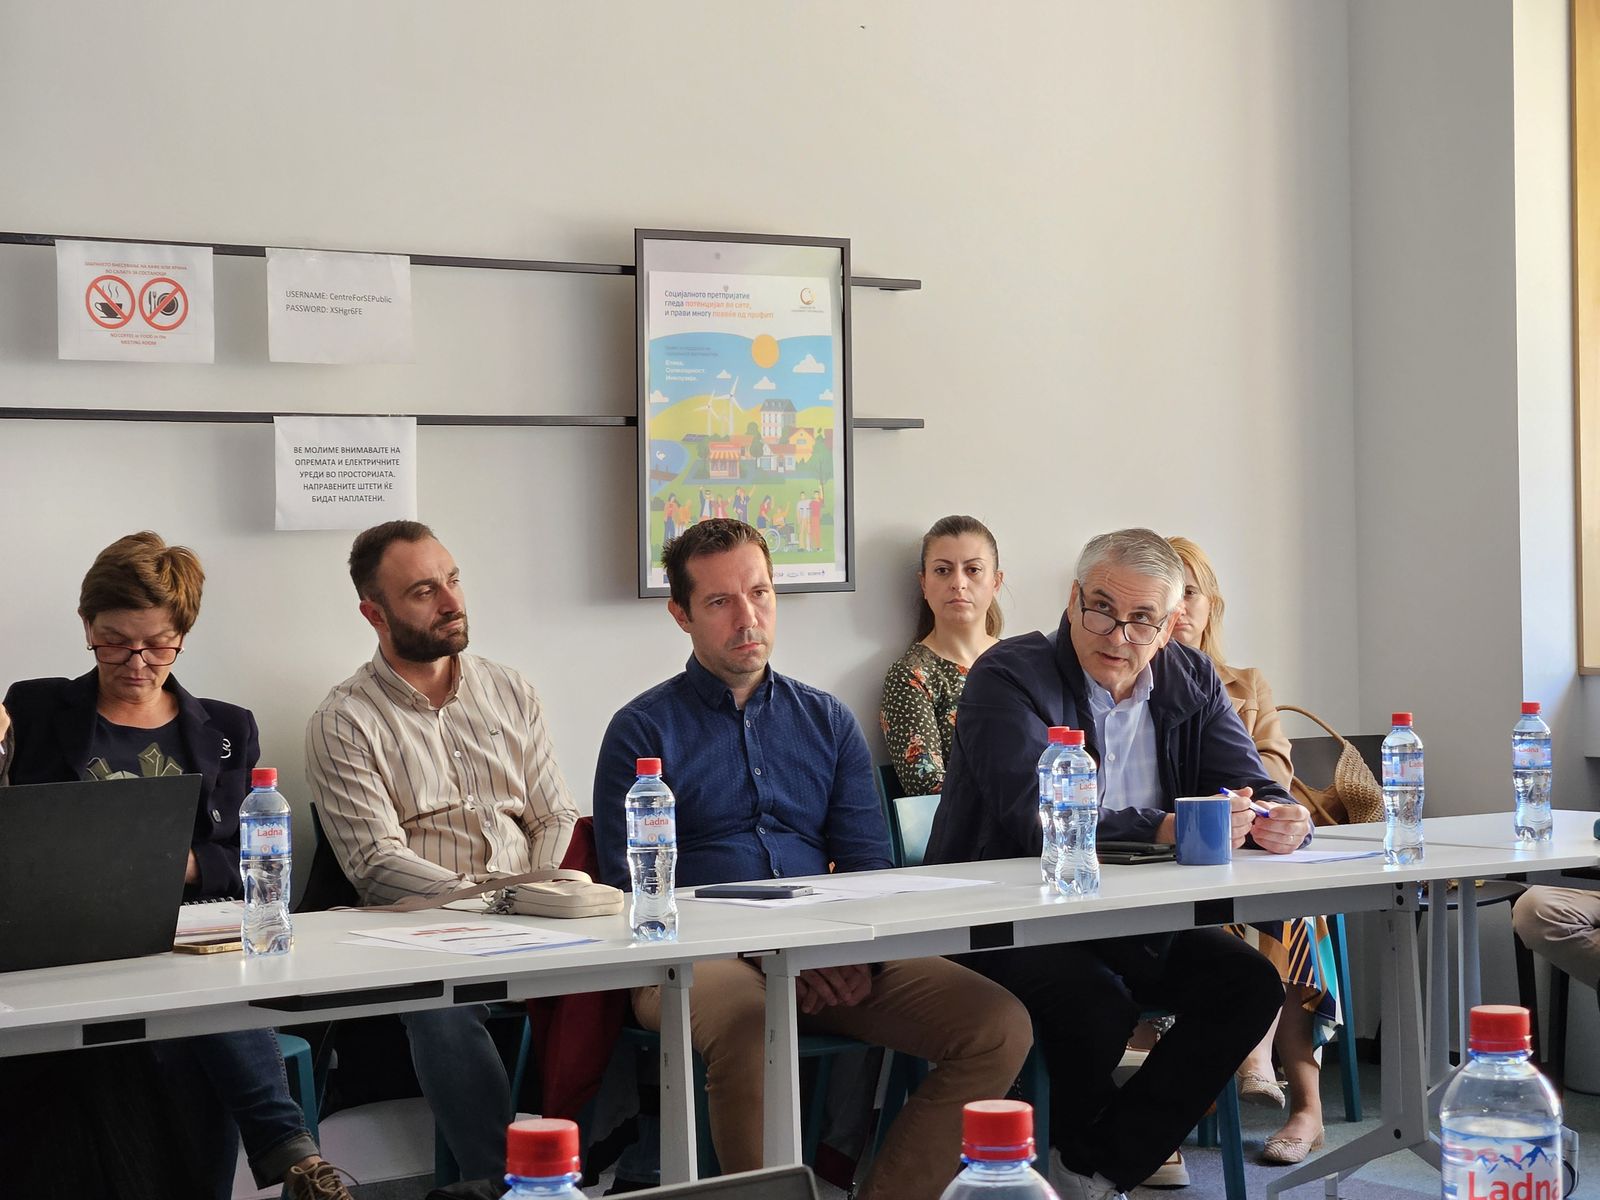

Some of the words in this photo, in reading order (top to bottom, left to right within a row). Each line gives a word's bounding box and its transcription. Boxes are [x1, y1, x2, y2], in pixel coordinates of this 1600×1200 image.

[285, 290, 329, 300] USERNAME:
[330, 292, 393, 303] CentreForSEPublic
[664, 290, 706, 300] Социјалното
[707, 291, 750, 300] претпријатие
[285, 304, 329, 314] PASSWORD:
[330, 307, 363, 316] XSHgr6FE
[671, 310, 691, 318] прави
[692, 310, 711, 318] многу
[293, 446, 302, 454] ВЕ
[304, 446, 339, 454] МОЛИМЕ
[341, 446, 388, 454] ВНИМАВАЈТЕ
[390, 446, 401, 454] НА
[345, 458, 400, 466] ЕЛЕКТРИЧНИТЕ
[299, 471, 324, 479] УРЕДИ
[338, 470, 396, 478] ПРОСТОРИЈАТА.
[358, 482, 383, 490] ШТЕТИ
[384, 481, 393, 490] ЌЕ
[311, 495, 337, 503] БИДАТ
[644, 817, 669, 826] Ladna
[257, 828, 283, 837] Ladna
